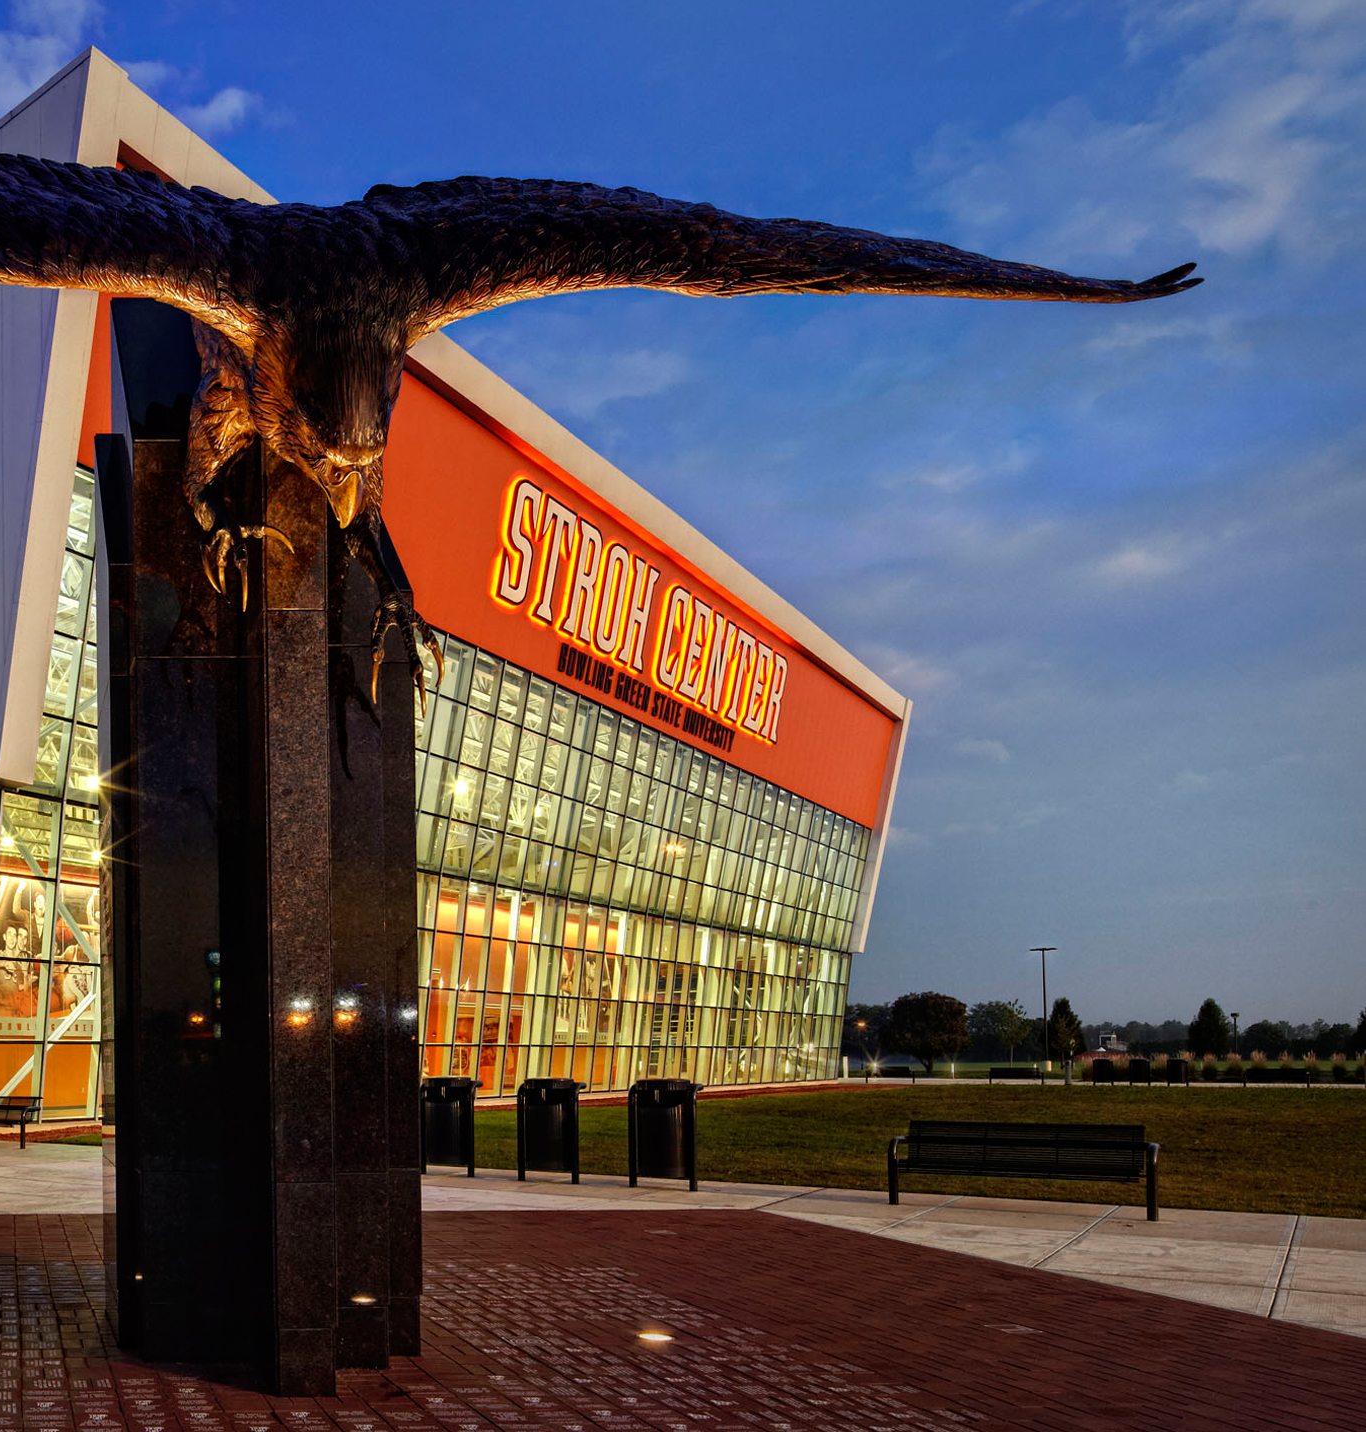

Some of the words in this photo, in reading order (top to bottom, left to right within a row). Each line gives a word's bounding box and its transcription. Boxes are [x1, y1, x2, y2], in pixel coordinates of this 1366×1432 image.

[499, 480, 660, 672] STROH
[658, 586, 788, 743] CENTER
[557, 643, 614, 694] BOWLING
[615, 672, 652, 712] GREEN
[651, 691, 683, 728] STATE
[682, 707, 736, 753] UNIVERSITY
